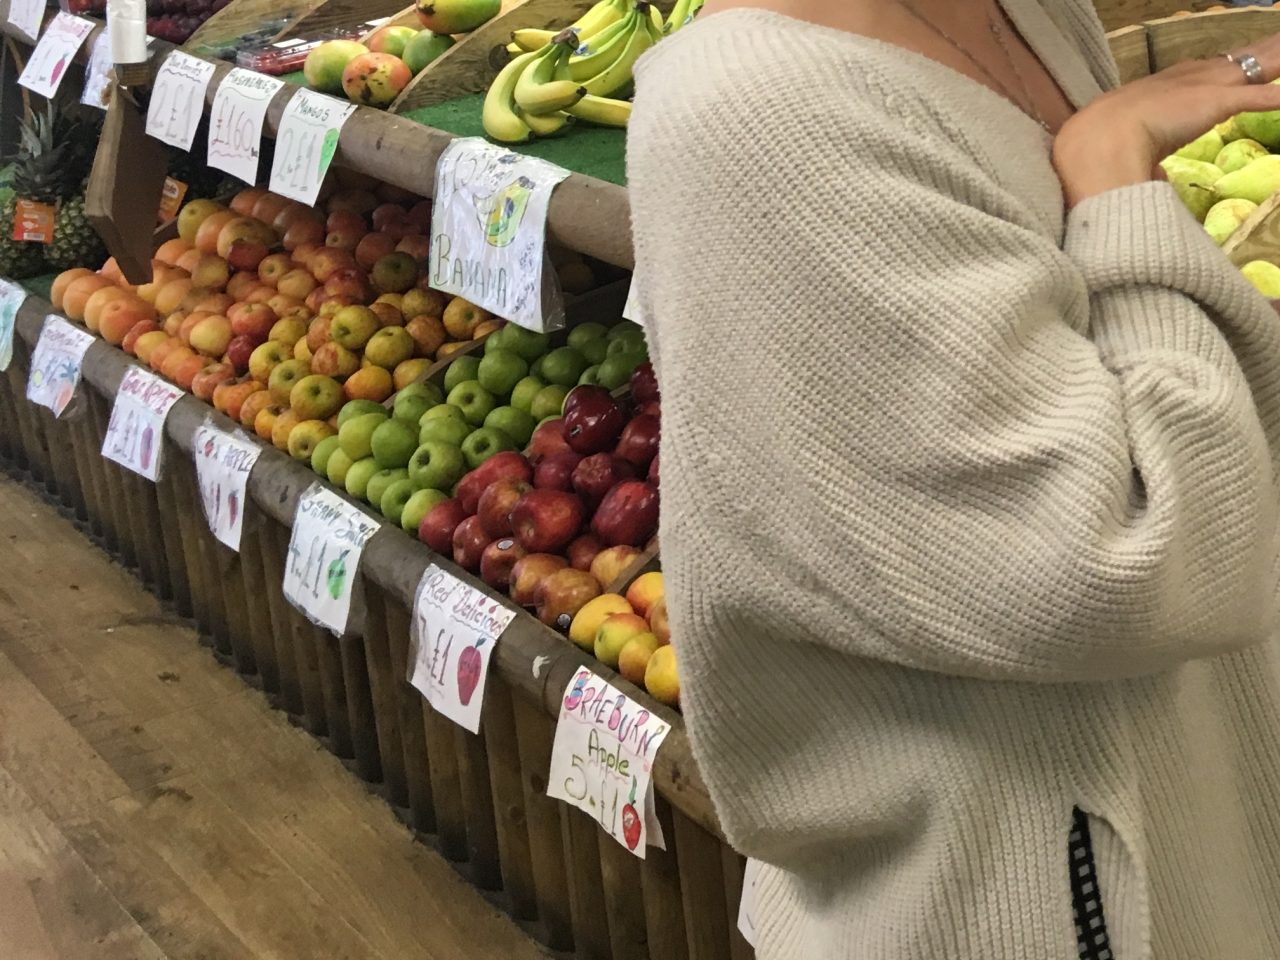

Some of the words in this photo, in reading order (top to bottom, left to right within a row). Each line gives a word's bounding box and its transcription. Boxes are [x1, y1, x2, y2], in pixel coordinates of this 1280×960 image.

[425, 573, 449, 605] Red
[431, 628, 454, 686] £1
[588, 728, 630, 779] Apple
